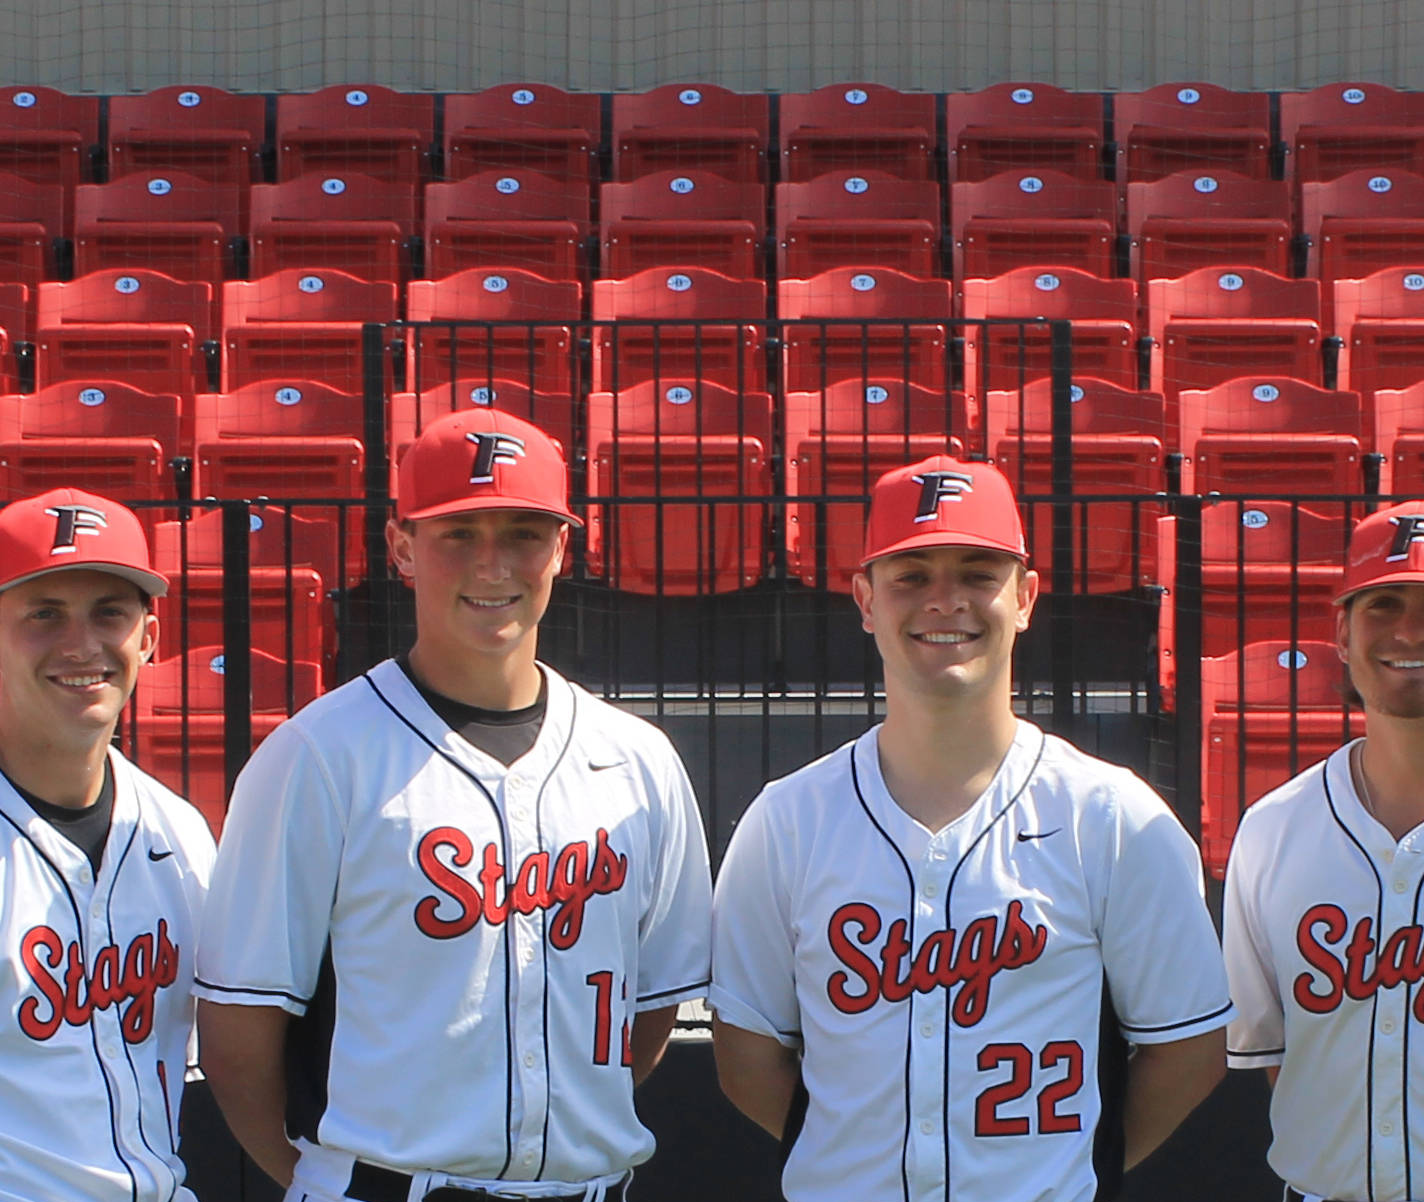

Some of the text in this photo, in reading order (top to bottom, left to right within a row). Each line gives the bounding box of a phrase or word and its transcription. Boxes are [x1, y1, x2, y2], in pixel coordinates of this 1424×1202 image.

[465, 432, 526, 485] F
[911, 470, 974, 524] F
[44, 504, 108, 556] F
[415, 825, 628, 951] Stags
[18, 919, 179, 1044] Stags
[828, 899, 1048, 1028] Stags
[586, 970, 633, 1067] 1
[975, 1040, 1084, 1138] 22
